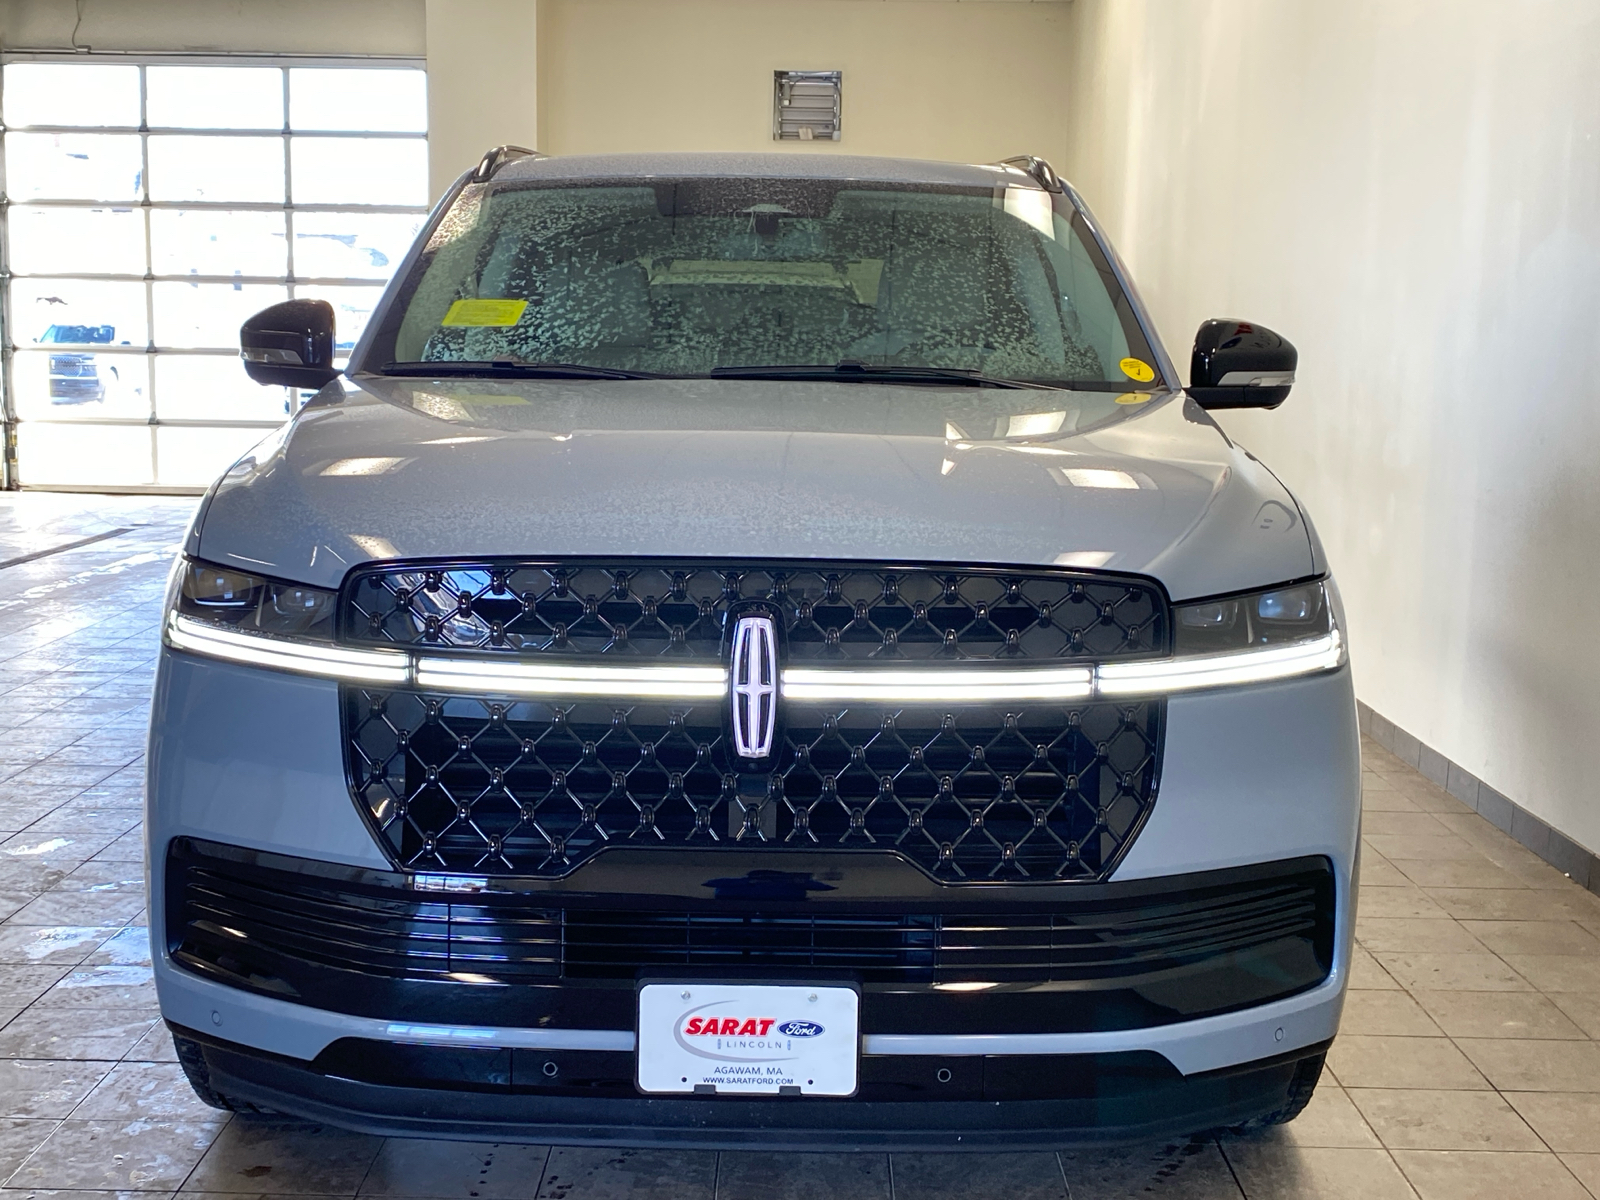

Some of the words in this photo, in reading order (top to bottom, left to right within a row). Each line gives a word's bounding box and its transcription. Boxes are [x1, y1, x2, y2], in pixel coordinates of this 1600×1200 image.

[684, 1017, 776, 1036] SARAT
[784, 1021, 818, 1036] Ford
[726, 1041, 782, 1049] LINCOLN
[714, 1066, 764, 1076] AGAWAM,
[766, 1067, 783, 1076] MA
[702, 1077, 794, 1085] WWW.SARATFORD.COM
